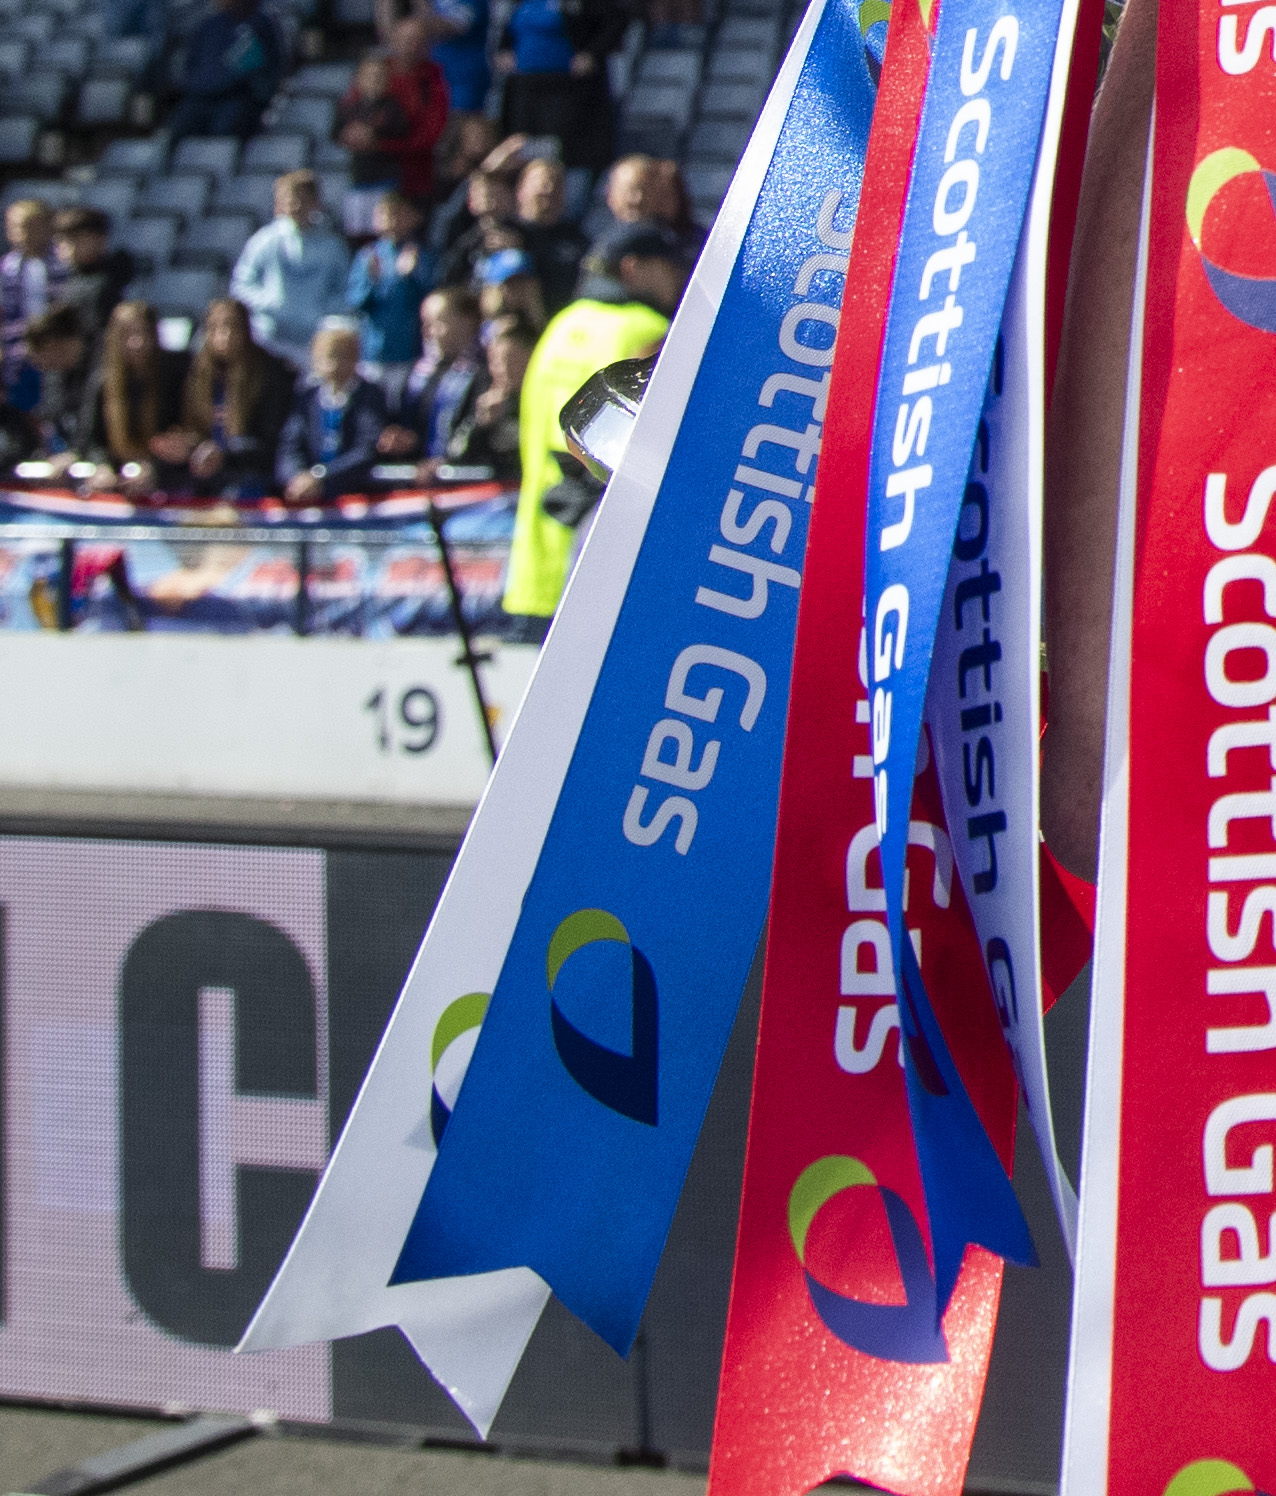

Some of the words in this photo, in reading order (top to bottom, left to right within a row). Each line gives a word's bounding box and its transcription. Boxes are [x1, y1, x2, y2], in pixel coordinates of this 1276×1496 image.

[880, 14, 1020, 553] Scottish
[361, 685, 444, 756] 19
[622, 642, 769, 857] Gas
[873, 583, 911, 842] Gas
